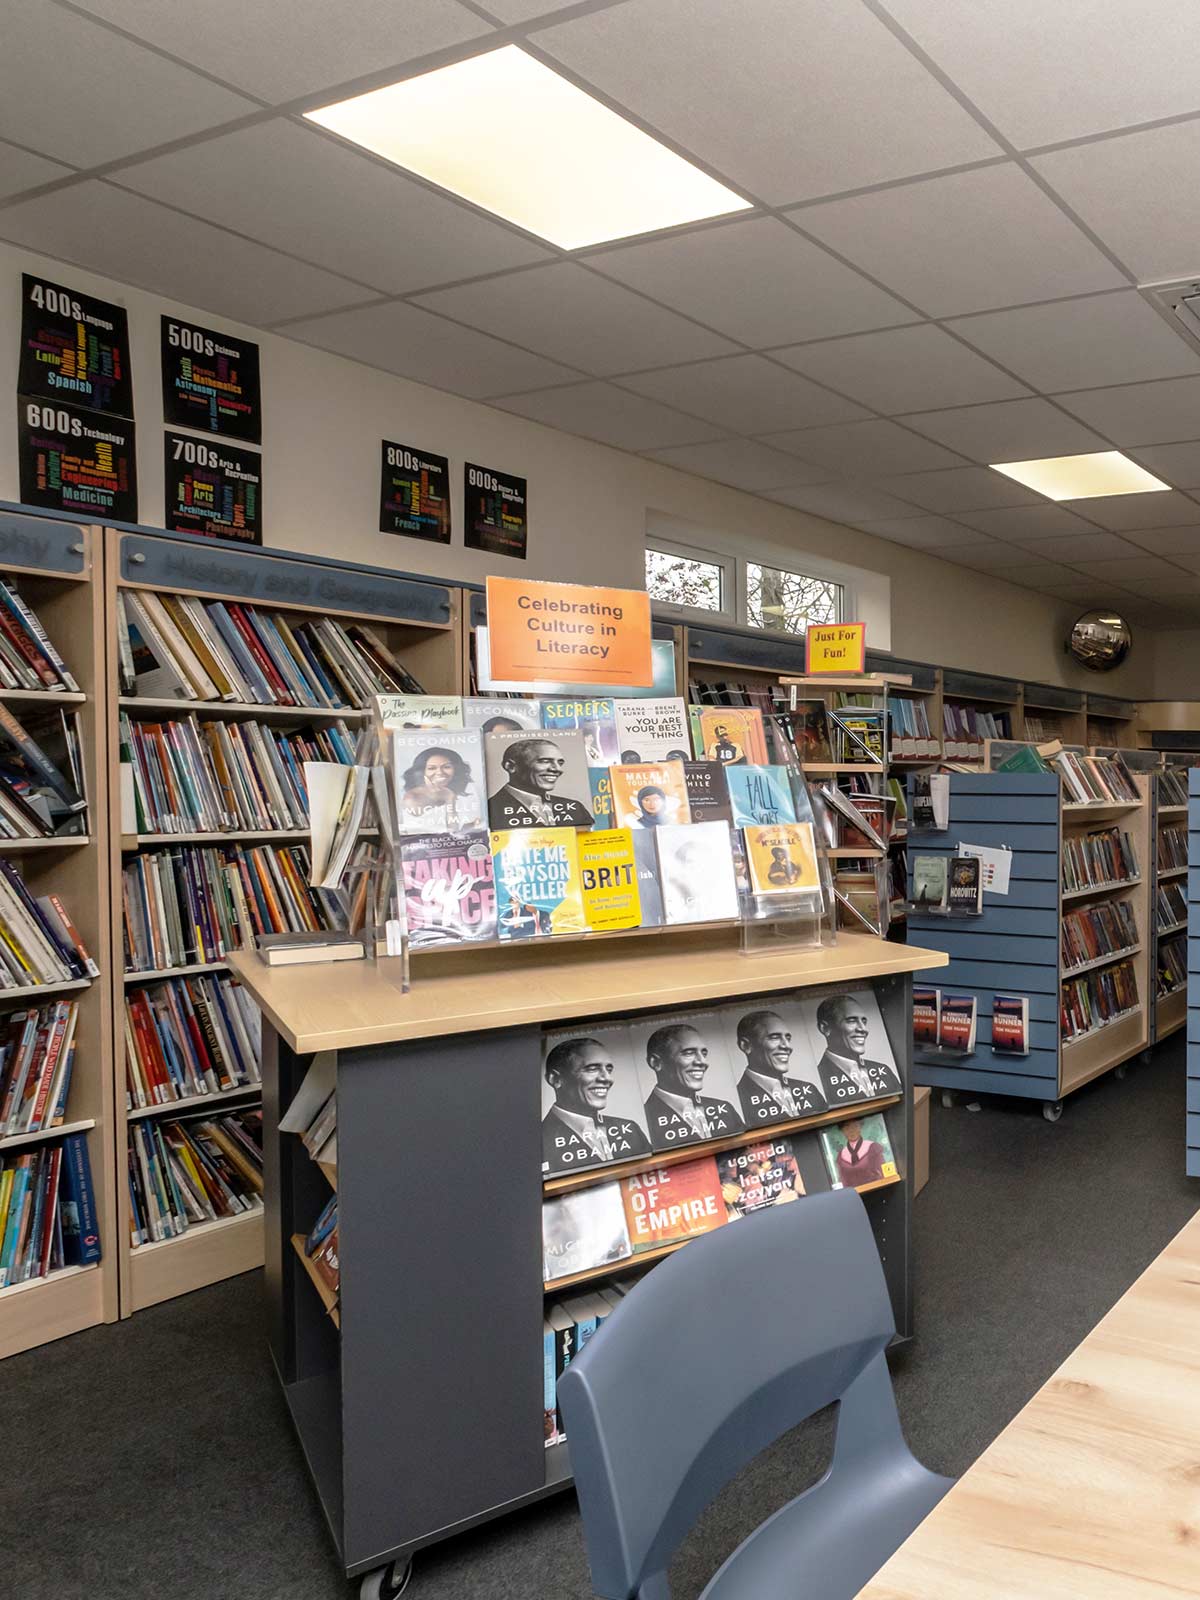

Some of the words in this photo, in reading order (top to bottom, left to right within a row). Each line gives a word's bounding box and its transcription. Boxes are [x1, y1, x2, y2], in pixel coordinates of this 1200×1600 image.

[30, 283, 82, 321] 400s
[168, 323, 214, 357] 500s
[47, 371, 93, 394] Spanish
[27, 403, 82, 437] 600s
[83, 426, 125, 446] Technology
[96, 441, 112, 472] Health
[172, 438, 218, 469] 700s
[387, 446, 419, 472] 800s
[61, 469, 118, 492] Engineering
[469, 468, 498, 492] 900s
[62, 485, 113, 507] Medicine
[193, 488, 214, 502] Arts
[518, 596, 623, 620] Celebrating
[527, 618, 595, 635] Culture
[601, 623, 617, 637] in
[815, 631, 835, 643] Just
[838, 630, 857, 641] For
[537, 640, 610, 659] Literacy
[823, 647, 847, 659] Fun!
[467, 706, 538, 718] BECOMING
[546, 701, 611, 718] SECRETS
[625, 725, 655, 733] YOUR
[658, 724, 682, 732] BEST
[636, 718, 658, 726] YOU
[399, 735, 479, 747] BECOMING
[500, 732, 550, 740] PROMISED
[650, 731, 683, 739] THING
[626, 772, 670, 782] MALALA
[504, 802, 578, 816] BARACK
[509, 814, 574, 827] OBAMA
[443, 840, 456, 848] FOR
[457, 838, 484, 847] CHANGE
[547, 845, 568, 863] ME
[504, 863, 570, 885] BRYSON
[582, 863, 633, 890] BRIT
[510, 880, 568, 901] KELLER
[950, 887, 977, 899] HOROWITZ
[913, 1009, 936, 1017] UNNER
[830, 1067, 887, 1086] BARACK
[751, 1085, 812, 1106] BARACK
[837, 1080, 888, 1098] OBAMA
[658, 1104, 728, 1127] BARACK
[758, 1100, 813, 1119] OBAMA
[555, 1123, 632, 1148] BARACK
[665, 1119, 727, 1141] OBAMA
[562, 1140, 631, 1163] OBAMA
[728, 1144, 785, 1168] uganda
[628, 1168, 671, 1191] AGE
[739, 1166, 783, 1188] hafsa
[631, 1188, 660, 1213] OF
[739, 1179, 792, 1203] zayyan
[634, 1194, 719, 1235] EMPIRE
